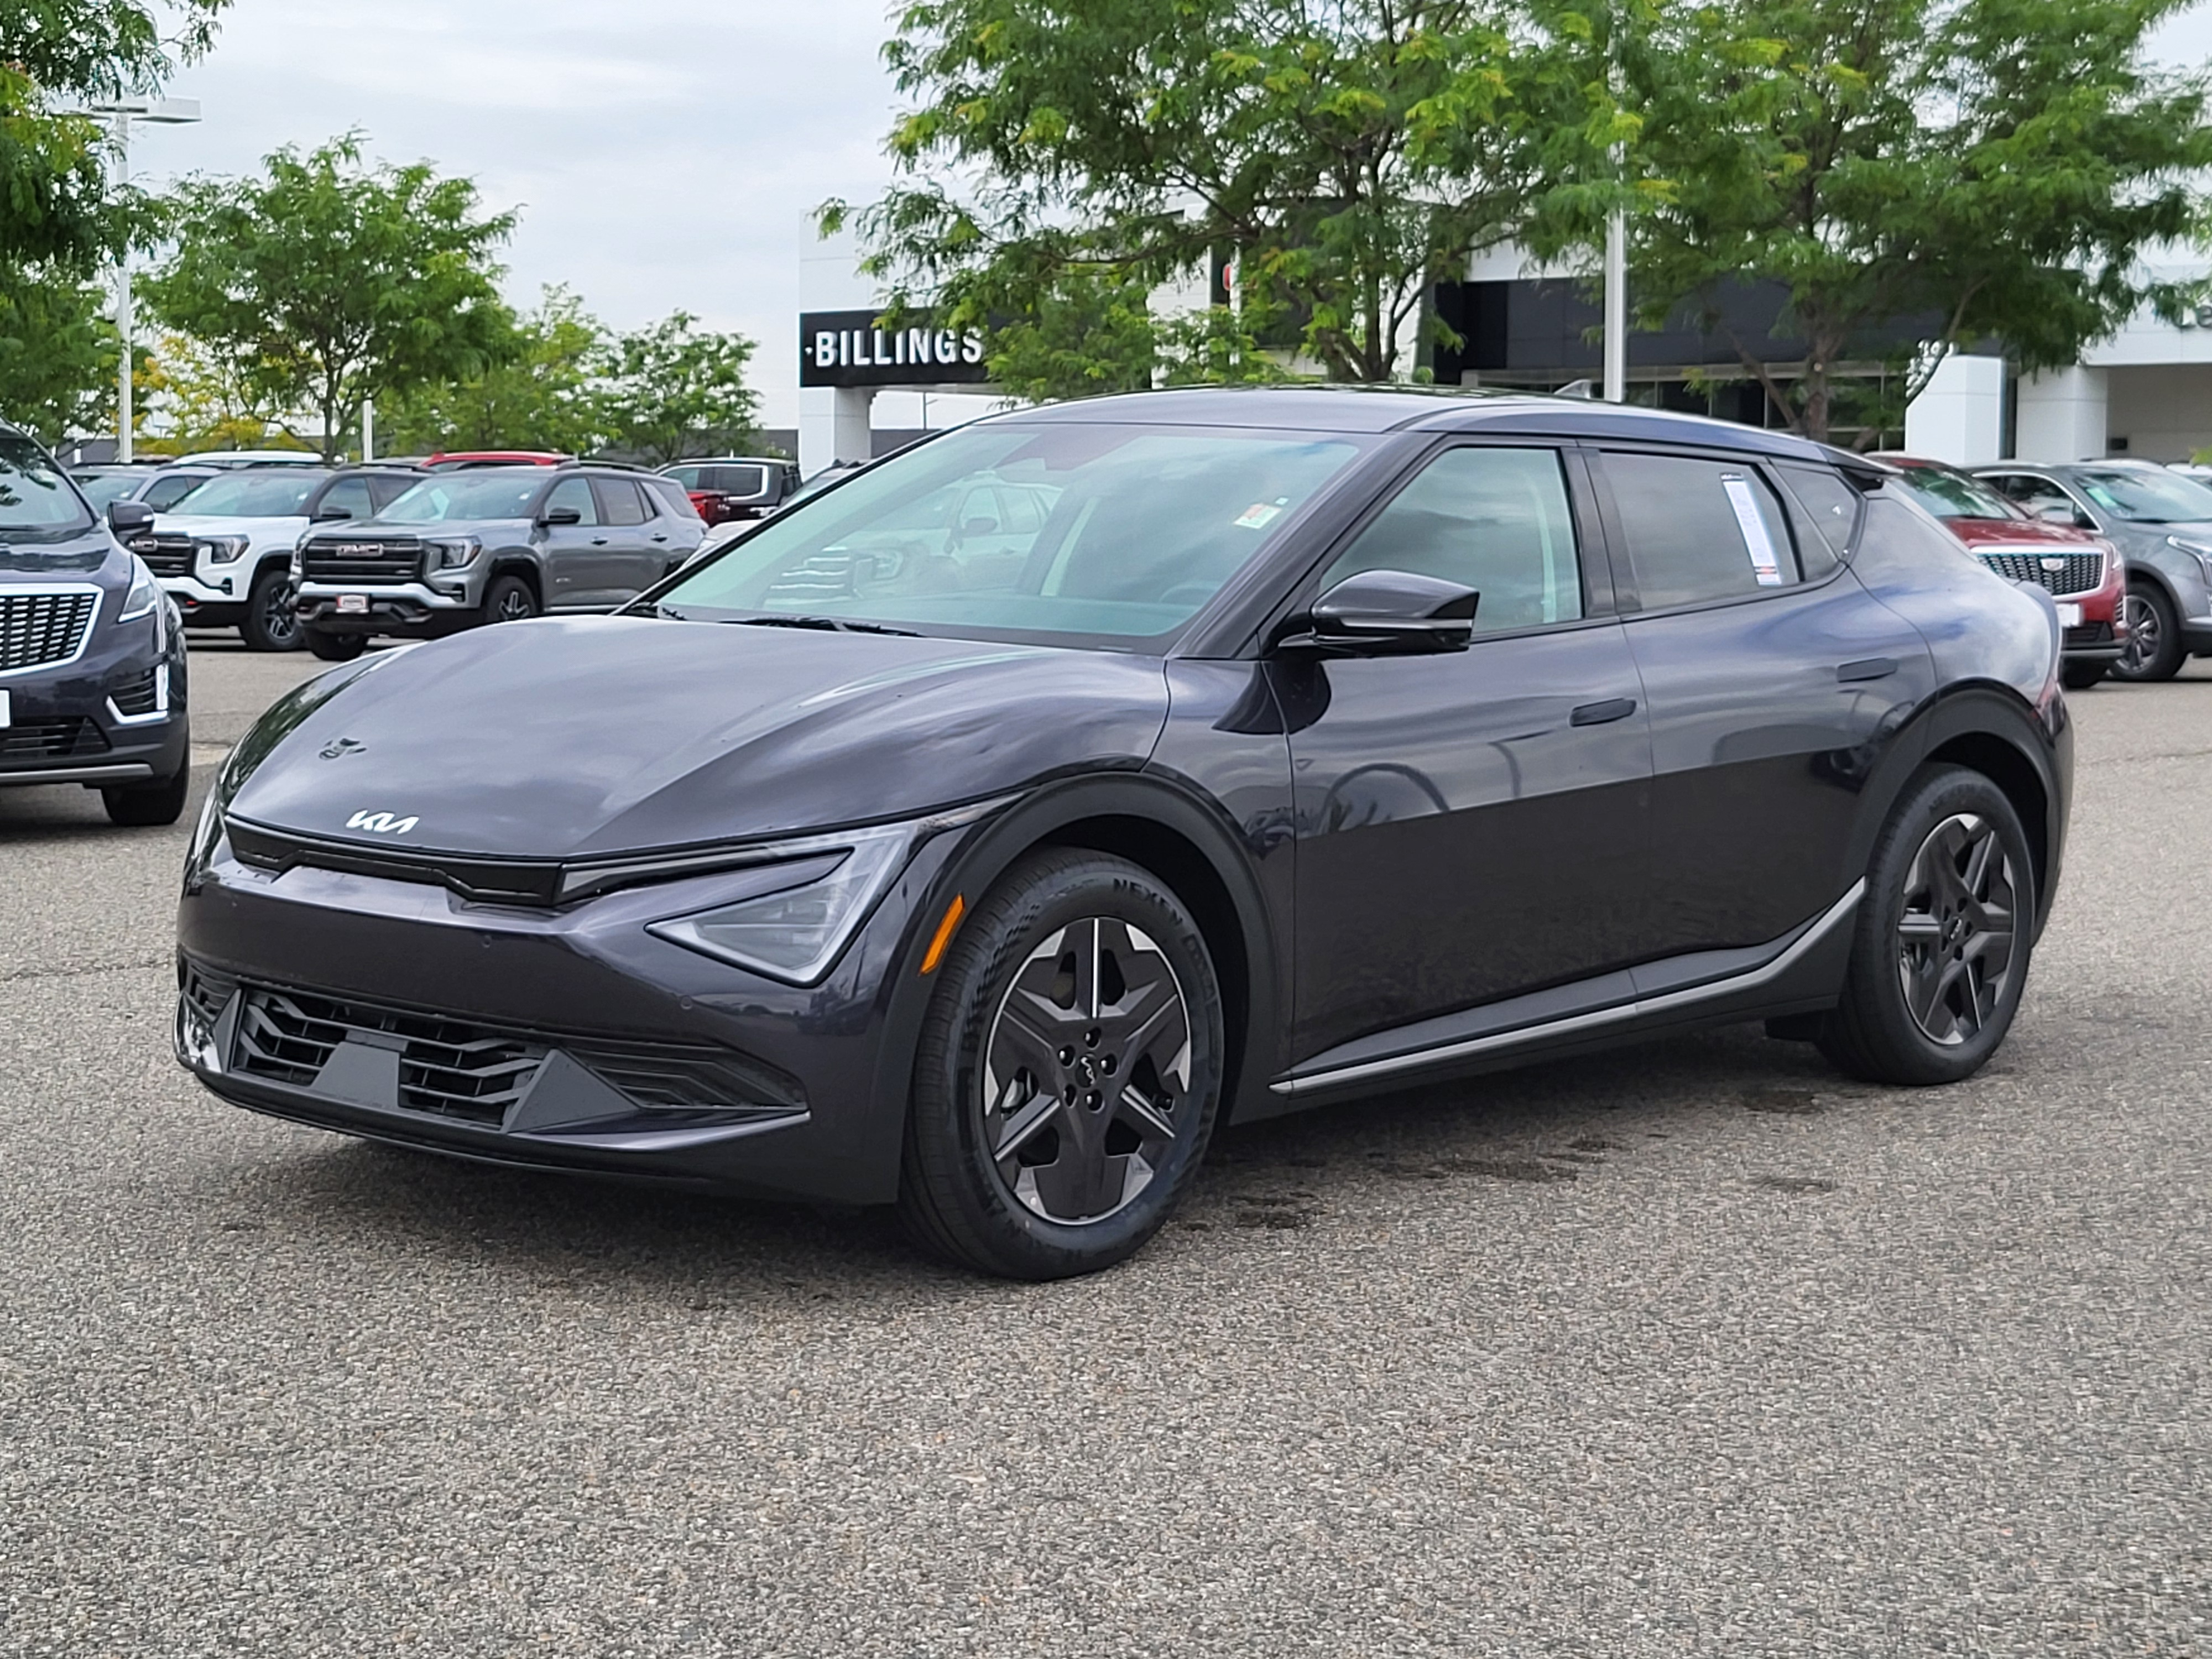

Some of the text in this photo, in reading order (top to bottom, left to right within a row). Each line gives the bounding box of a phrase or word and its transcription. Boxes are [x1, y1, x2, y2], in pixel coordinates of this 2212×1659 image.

[816, 328, 983, 367] BILLINGS
[346, 809, 420, 835] KIA
[1113, 878, 1183, 925] NEXEN
